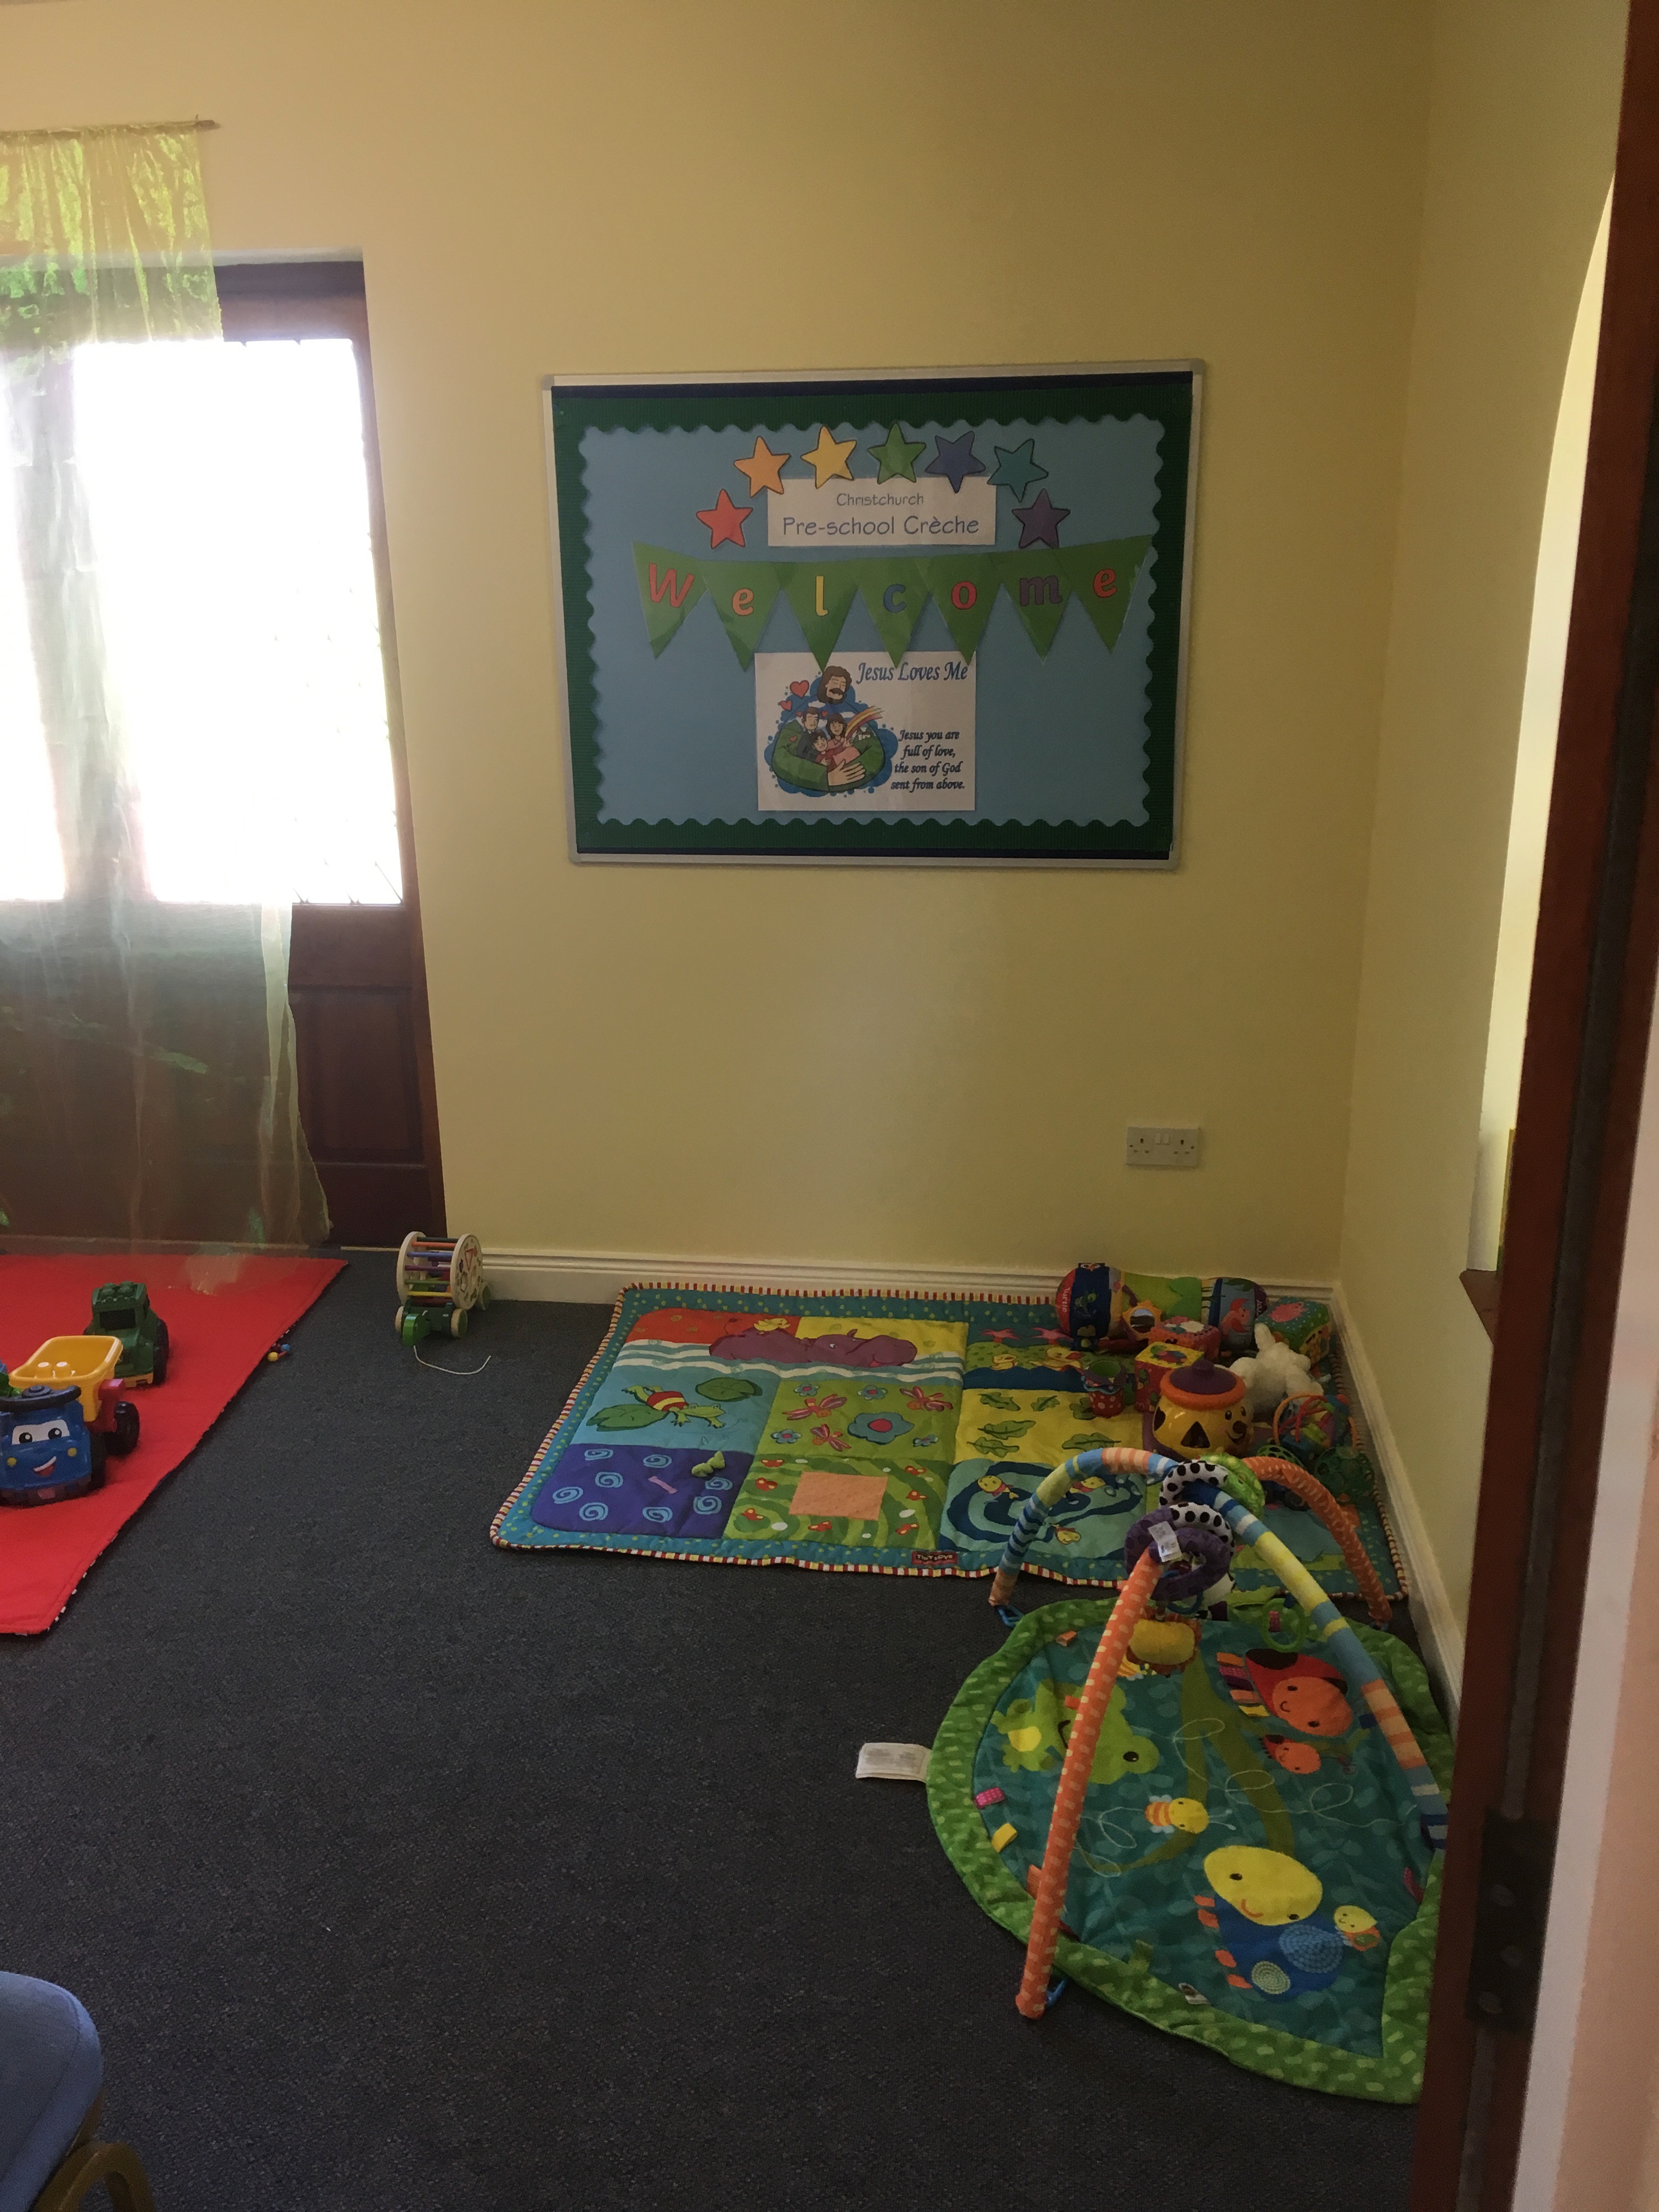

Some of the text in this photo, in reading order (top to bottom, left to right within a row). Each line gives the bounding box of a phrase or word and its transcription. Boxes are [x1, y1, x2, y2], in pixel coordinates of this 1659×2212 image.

[836, 493, 924, 506] Christchurch
[783, 515, 979, 535] Pre-school Crèche
[648, 562, 1118, 617] Welcome
[856, 661, 969, 685] Jesus Loves Me
[898, 730, 960, 743] Jesus you are
[900, 744, 956, 760] full of love,
[894, 760, 963, 777] the son of God
[890, 777, 965, 793] sent from above.
